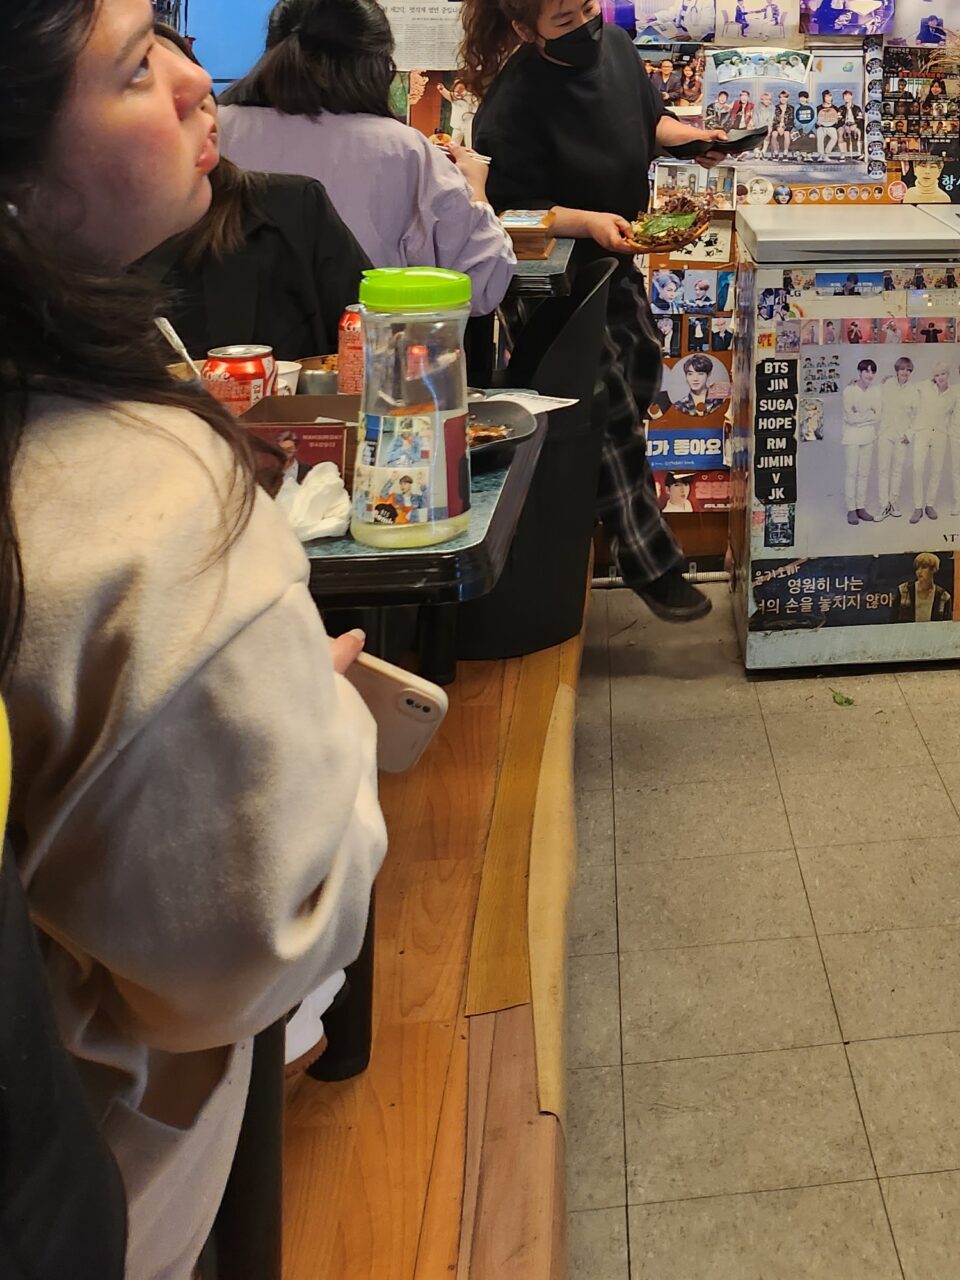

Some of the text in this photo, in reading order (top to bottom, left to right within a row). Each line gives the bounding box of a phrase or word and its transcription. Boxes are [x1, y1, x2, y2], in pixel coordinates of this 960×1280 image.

[764, 361, 789, 374] BTS
[767, 378, 789, 392] JIN
[759, 399, 794, 412] SUGA
[758, 417, 793, 430] HOPE
[673, 438, 722, 456] 좋아요
[766, 437, 787, 450] RM
[756, 455, 793, 469] JIMIN
[772, 473, 781, 484] V
[768, 487, 785, 500] JK
[788, 575, 865, 595] 영원히 나는
[784, 597, 813, 613] 손을
[818, 593, 862, 613] 놓치지
[865, 592, 895, 609] 않아
